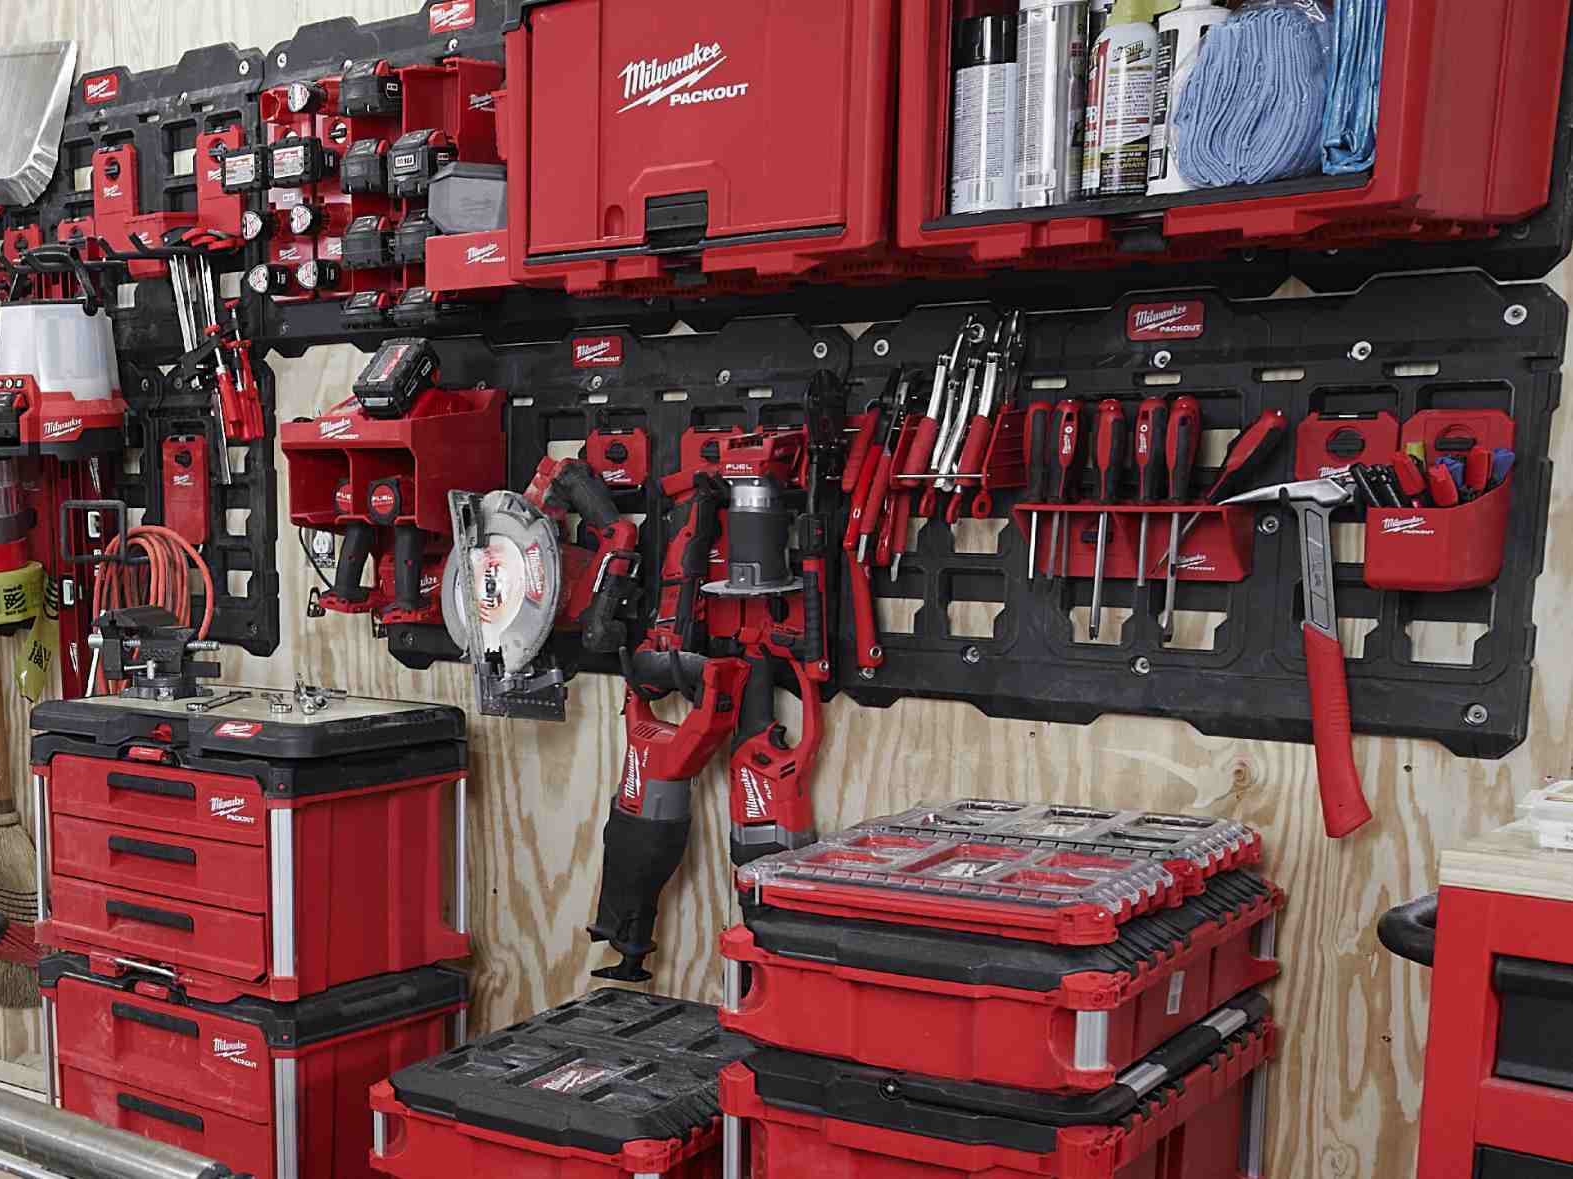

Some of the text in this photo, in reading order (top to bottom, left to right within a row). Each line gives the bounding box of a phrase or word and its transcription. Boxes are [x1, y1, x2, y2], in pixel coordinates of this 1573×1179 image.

[617, 42, 722, 99] Milwaukee
[669, 83, 749, 106] PACKOUT
[1134, 304, 1187, 327] Milwaukee
[43, 417, 83, 434] Milwaukee
[625, 744, 636, 799] Milwaukee
[740, 767, 763, 818] Milwaukee
